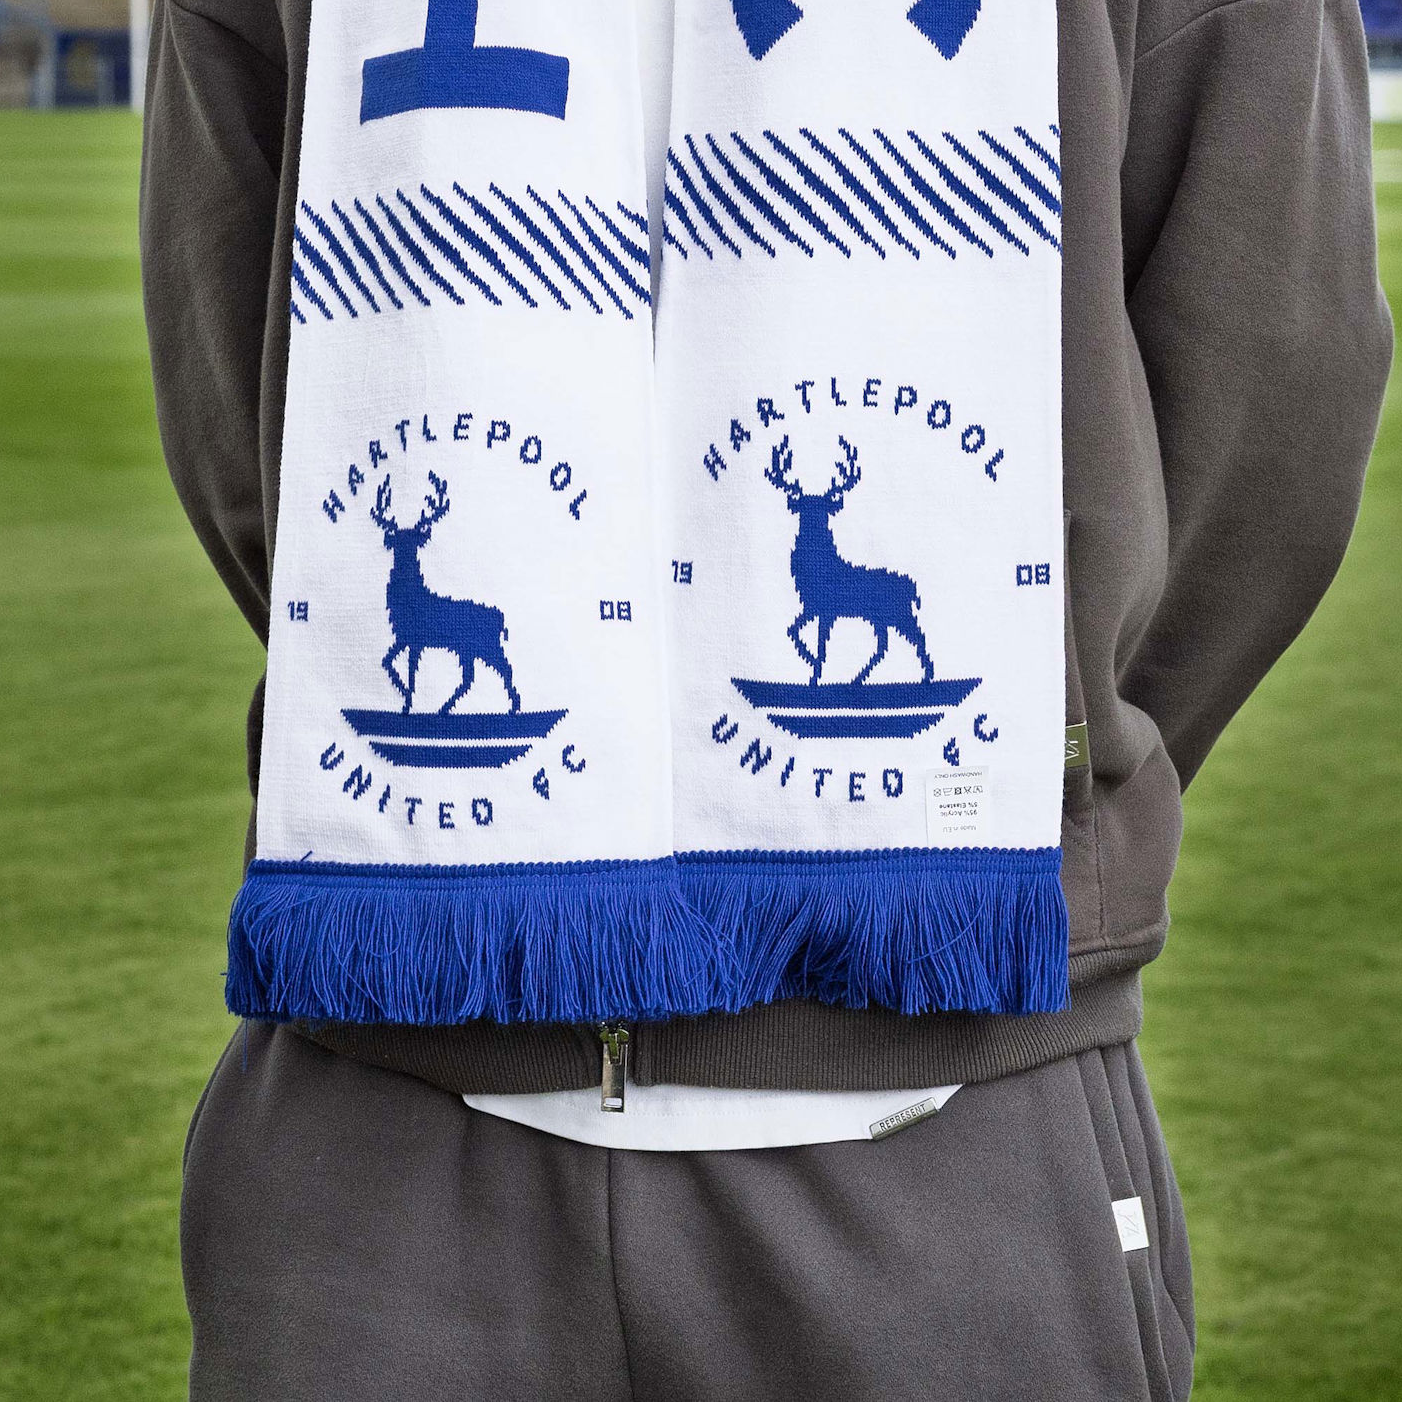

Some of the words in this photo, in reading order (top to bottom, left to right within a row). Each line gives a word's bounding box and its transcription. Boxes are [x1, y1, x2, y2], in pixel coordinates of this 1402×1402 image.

[703, 377, 1004, 482] HARTLEPOOL
[322, 412, 587, 524] HARTLEPOOL
[671, 560, 693, 584] 19
[1016, 563, 1051, 587] 08
[287, 601, 309, 622] 19
[599, 600, 632, 622] 08
[711, 714, 903, 803] UNITED
[319, 742, 494, 830] UNITED
[879, 1102, 927, 1133] REPRESENT
